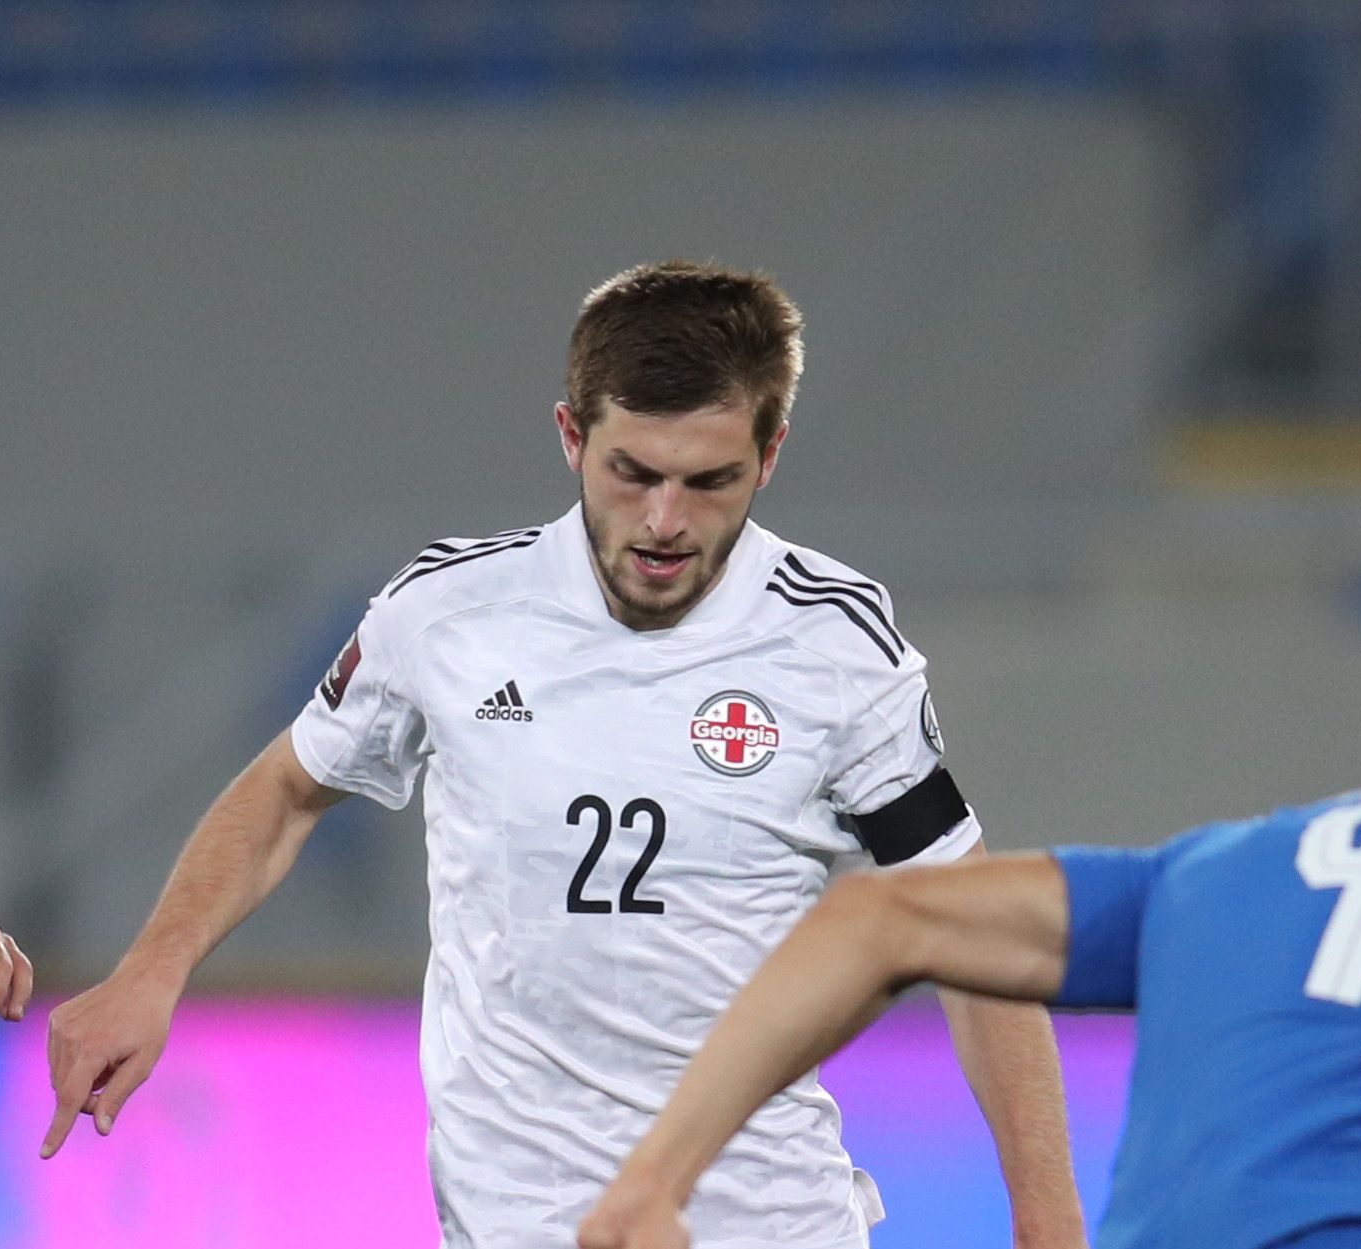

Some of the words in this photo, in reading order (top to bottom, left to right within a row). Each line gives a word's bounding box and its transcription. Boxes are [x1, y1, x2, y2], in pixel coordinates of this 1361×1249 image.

[475, 704, 533, 722] adidas
[692, 720, 778, 747] Georgia
[566, 794, 666, 914] 22
